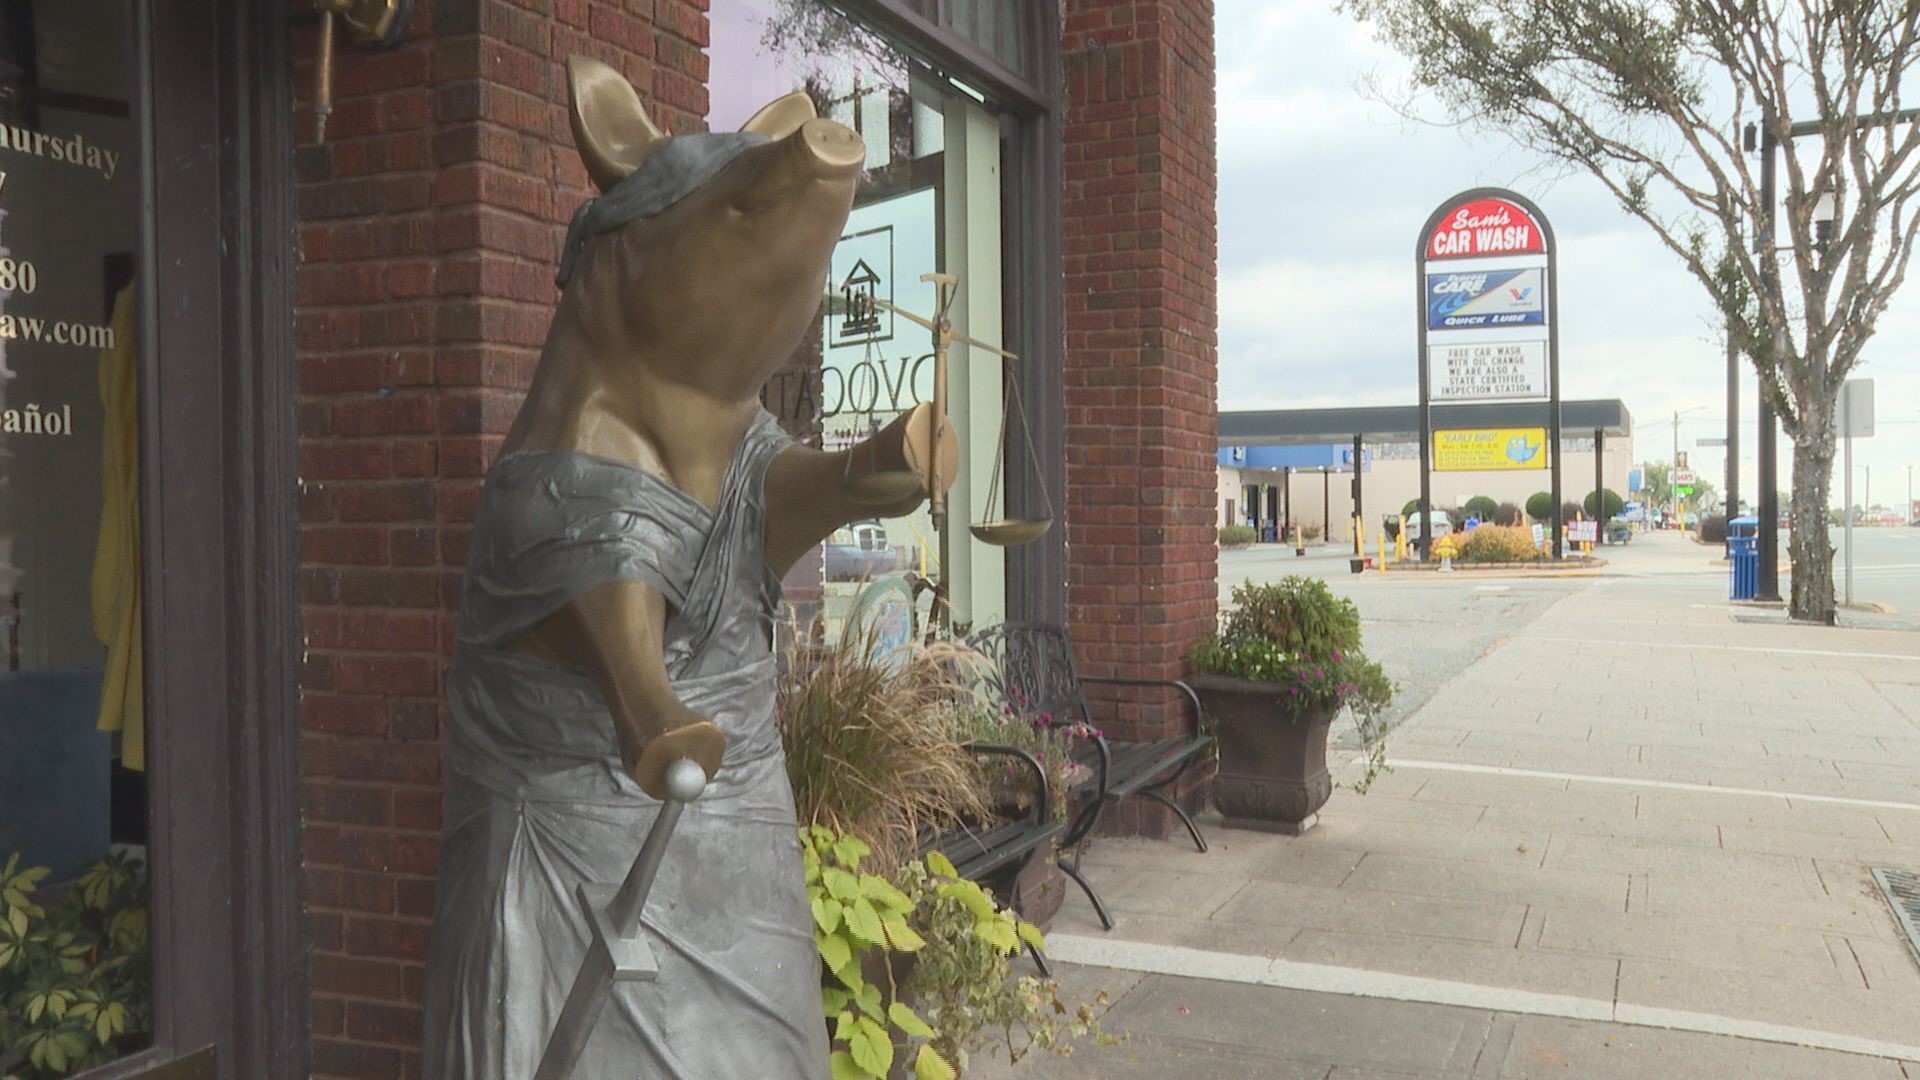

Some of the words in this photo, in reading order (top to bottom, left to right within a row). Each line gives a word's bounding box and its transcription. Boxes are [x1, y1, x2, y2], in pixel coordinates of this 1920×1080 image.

[1452, 206, 1511, 229] Sam's
[1433, 231, 1472, 255] CAR
[1476, 226, 1529, 253] WASH
[0, 258, 37, 294] 80
[1448, 348, 1469, 357] FREE
[1474, 347, 1491, 356] CAR
[1497, 346, 1521, 355] WASH
[1447, 358, 1468, 367] WITH
[1473, 357, 1487, 366] OIL
[1491, 356, 1524, 365] CHANGE
[1449, 367, 1460, 376] WE
[1465, 366, 1481, 375] ARE
[1486, 365, 1508, 375] ALSO
[1512, 365, 1518, 373] A
[1449, 376, 1475, 385] STATE
[1481, 375, 1525, 384] CERTIFIED
[1441, 385, 1491, 395] INSPECTION
[1495, 384, 1531, 393] STATION
[0, 403, 71, 436] añol
